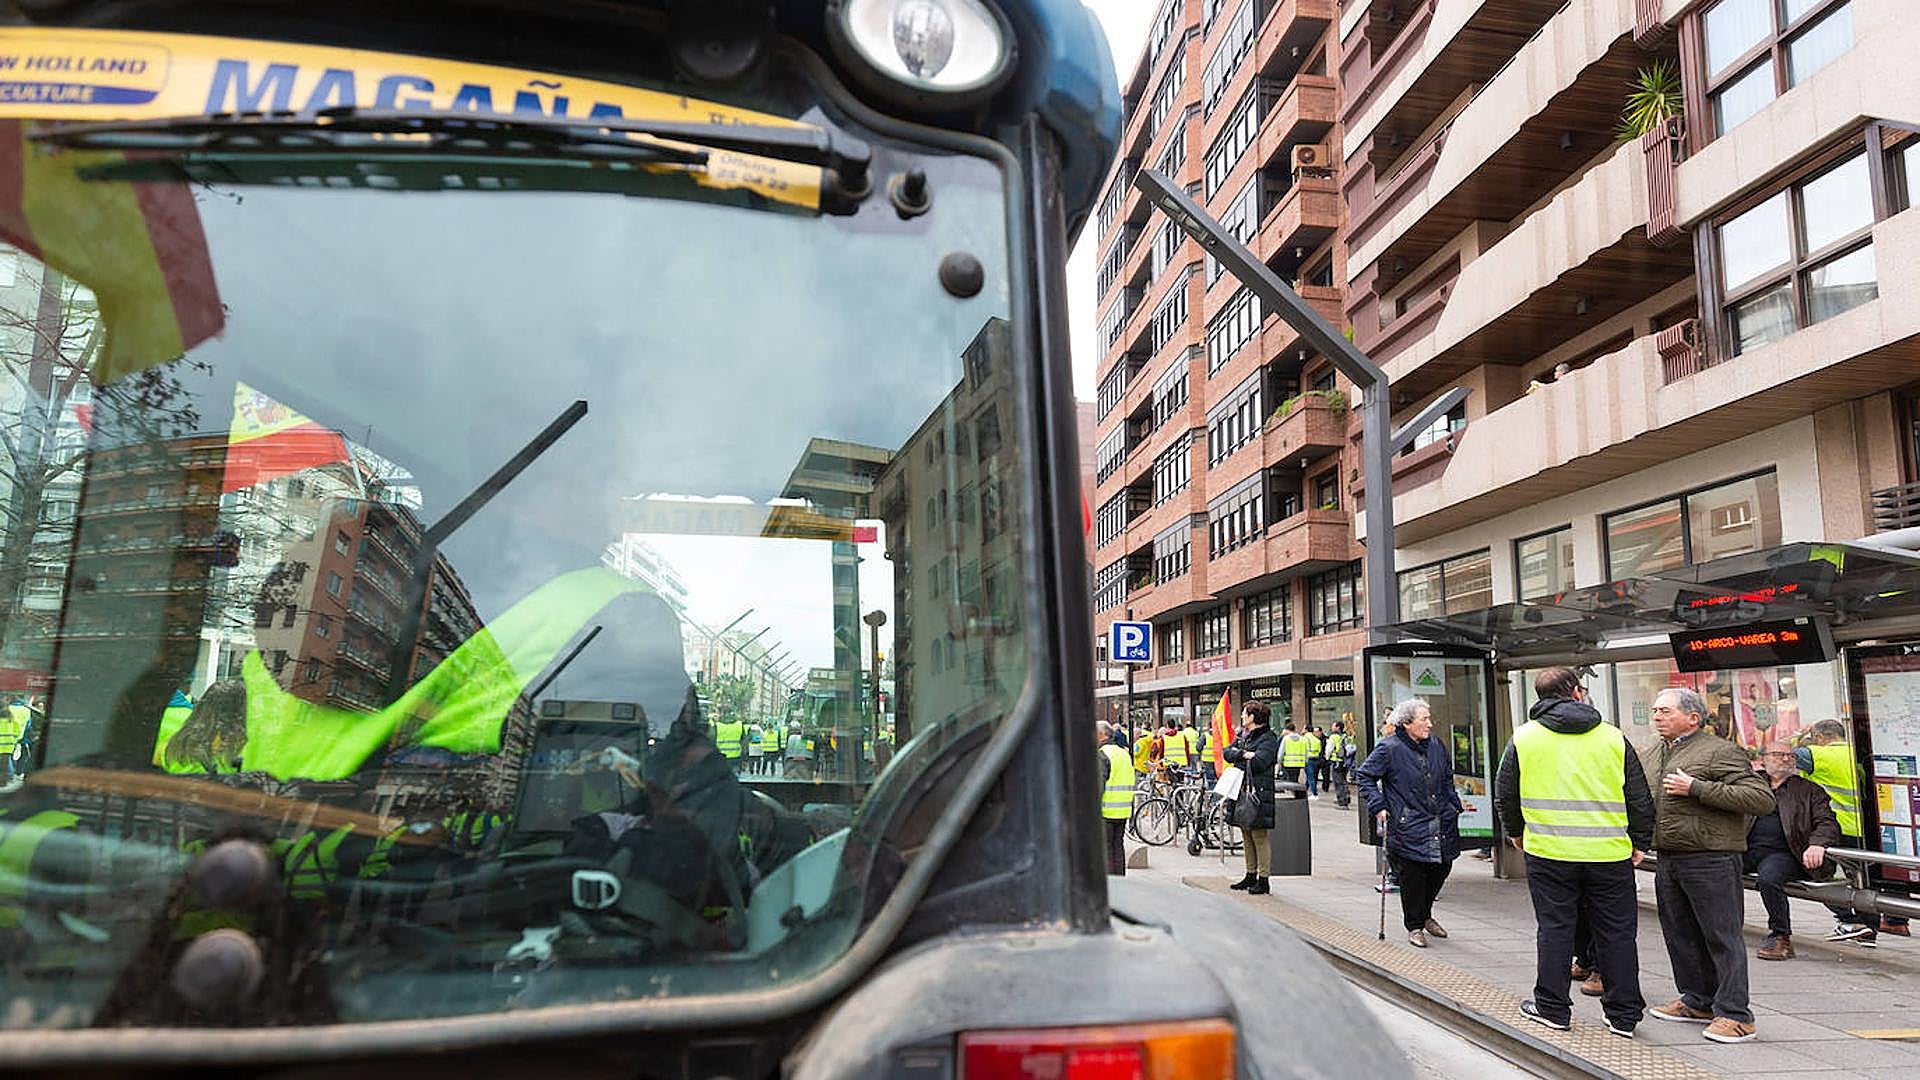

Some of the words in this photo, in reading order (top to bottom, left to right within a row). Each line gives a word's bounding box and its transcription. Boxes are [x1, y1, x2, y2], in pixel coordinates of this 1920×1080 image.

[26, 55, 149, 75] HOLLAND
[205, 59, 625, 119] MAGAÑ
[1120, 625, 1144, 658] P
[1315, 680, 1354, 693] CORTEFIEL
